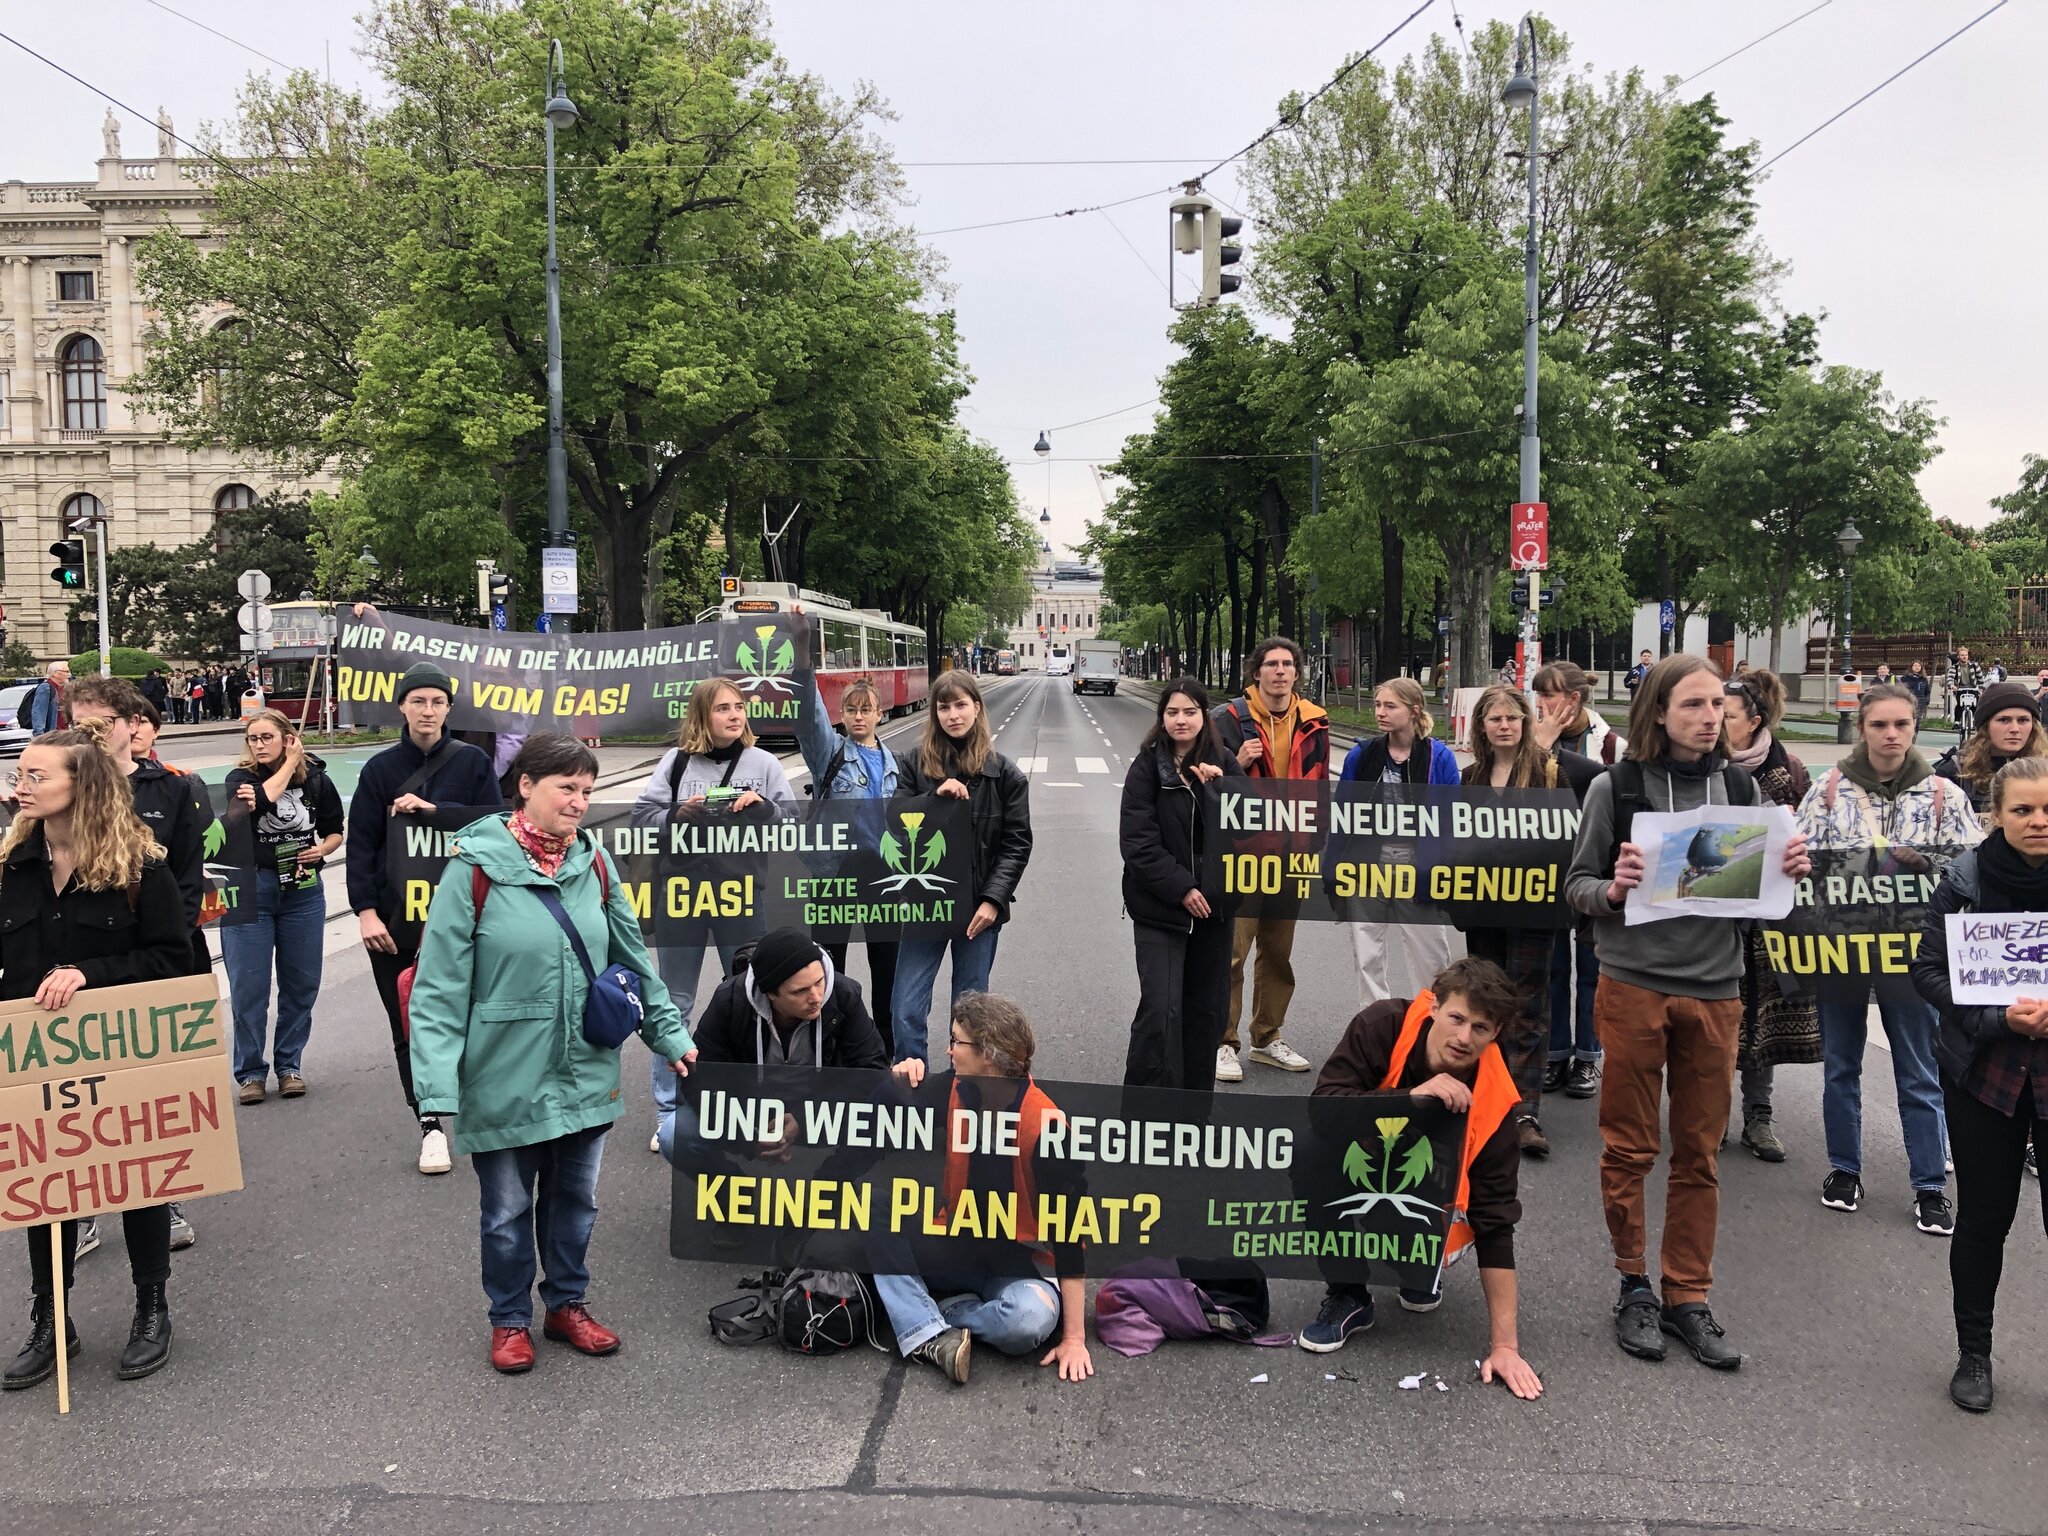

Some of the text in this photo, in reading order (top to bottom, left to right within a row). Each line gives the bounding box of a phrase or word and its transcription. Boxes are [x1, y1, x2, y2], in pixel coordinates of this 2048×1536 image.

[1516, 521, 1544, 532] PRATER
[726, 580, 735, 590] 2
[341, 624, 719, 671] WIR RASEN IN DIE KLIMAHÖLLE.
[338, 666, 631, 717] RUN VOM GAS!
[652, 680, 702, 698] LETZ
[668, 700, 801, 720] GEION.AT
[1220, 792, 1318, 833] KEINE
[1330, 801, 1440, 838] NEUEN
[614, 827, 660, 855] DIE
[671, 818, 858, 854] KLIMAHÖLLE.
[784, 877, 858, 898] LETZTE
[1222, 852, 1558, 903] 100 KM H SIND GENUG!
[1826, 873, 1941, 906] RASEN
[666, 875, 754, 918] GAS!
[804, 900, 955, 925] GENERATION.AT
[43, 1075, 106, 1111] IST
[699, 1089, 1294, 1170] UND WENN DIE REGIERUNG
[1, 1148, 204, 1222] SCHUTZ
[696, 1173, 1162, 1244] KEINEN PLAN HAT?
[1207, 1198, 1308, 1226] LETZTE
[1232, 1230, 1442, 1268] GENERATION.AT
